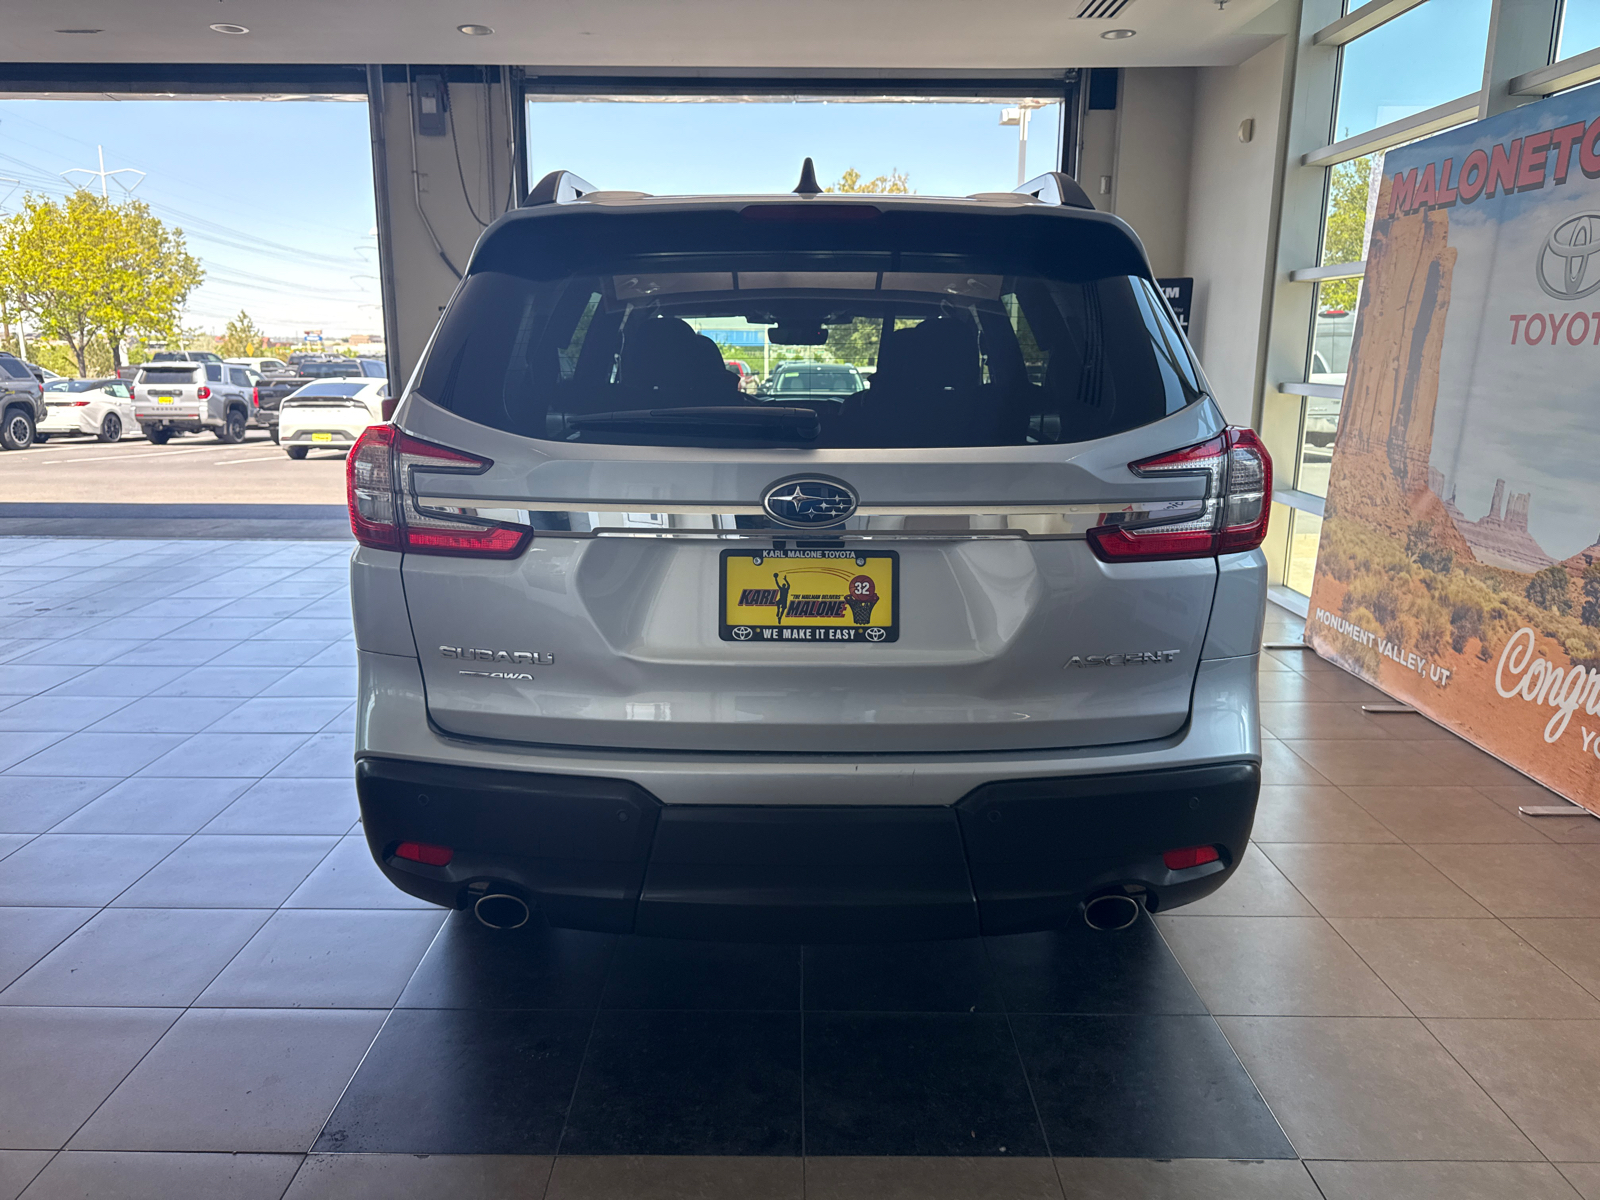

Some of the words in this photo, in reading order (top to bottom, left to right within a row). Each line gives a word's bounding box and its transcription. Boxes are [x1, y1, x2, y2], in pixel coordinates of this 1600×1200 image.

[1161, 287, 1180, 298] M
[763, 550, 785, 558] KARL
[825, 551, 856, 559] TOYOTA
[854, 582, 870, 595] 32
[738, 589, 779, 606] KARL
[785, 600, 847, 618] MALONE
[763, 628, 779, 639] WE
[783, 628, 812, 639] MAKE
[816, 629, 826, 639] IT
[829, 629, 856, 640] EASY
[1316, 607, 1375, 648] MONUMENT
[1378, 638, 1426, 678] VALLEY,
[1430, 664, 1450, 686] UT
[439, 645, 555, 666] SUBARU
[1063, 649, 1180, 669] ASCENT
